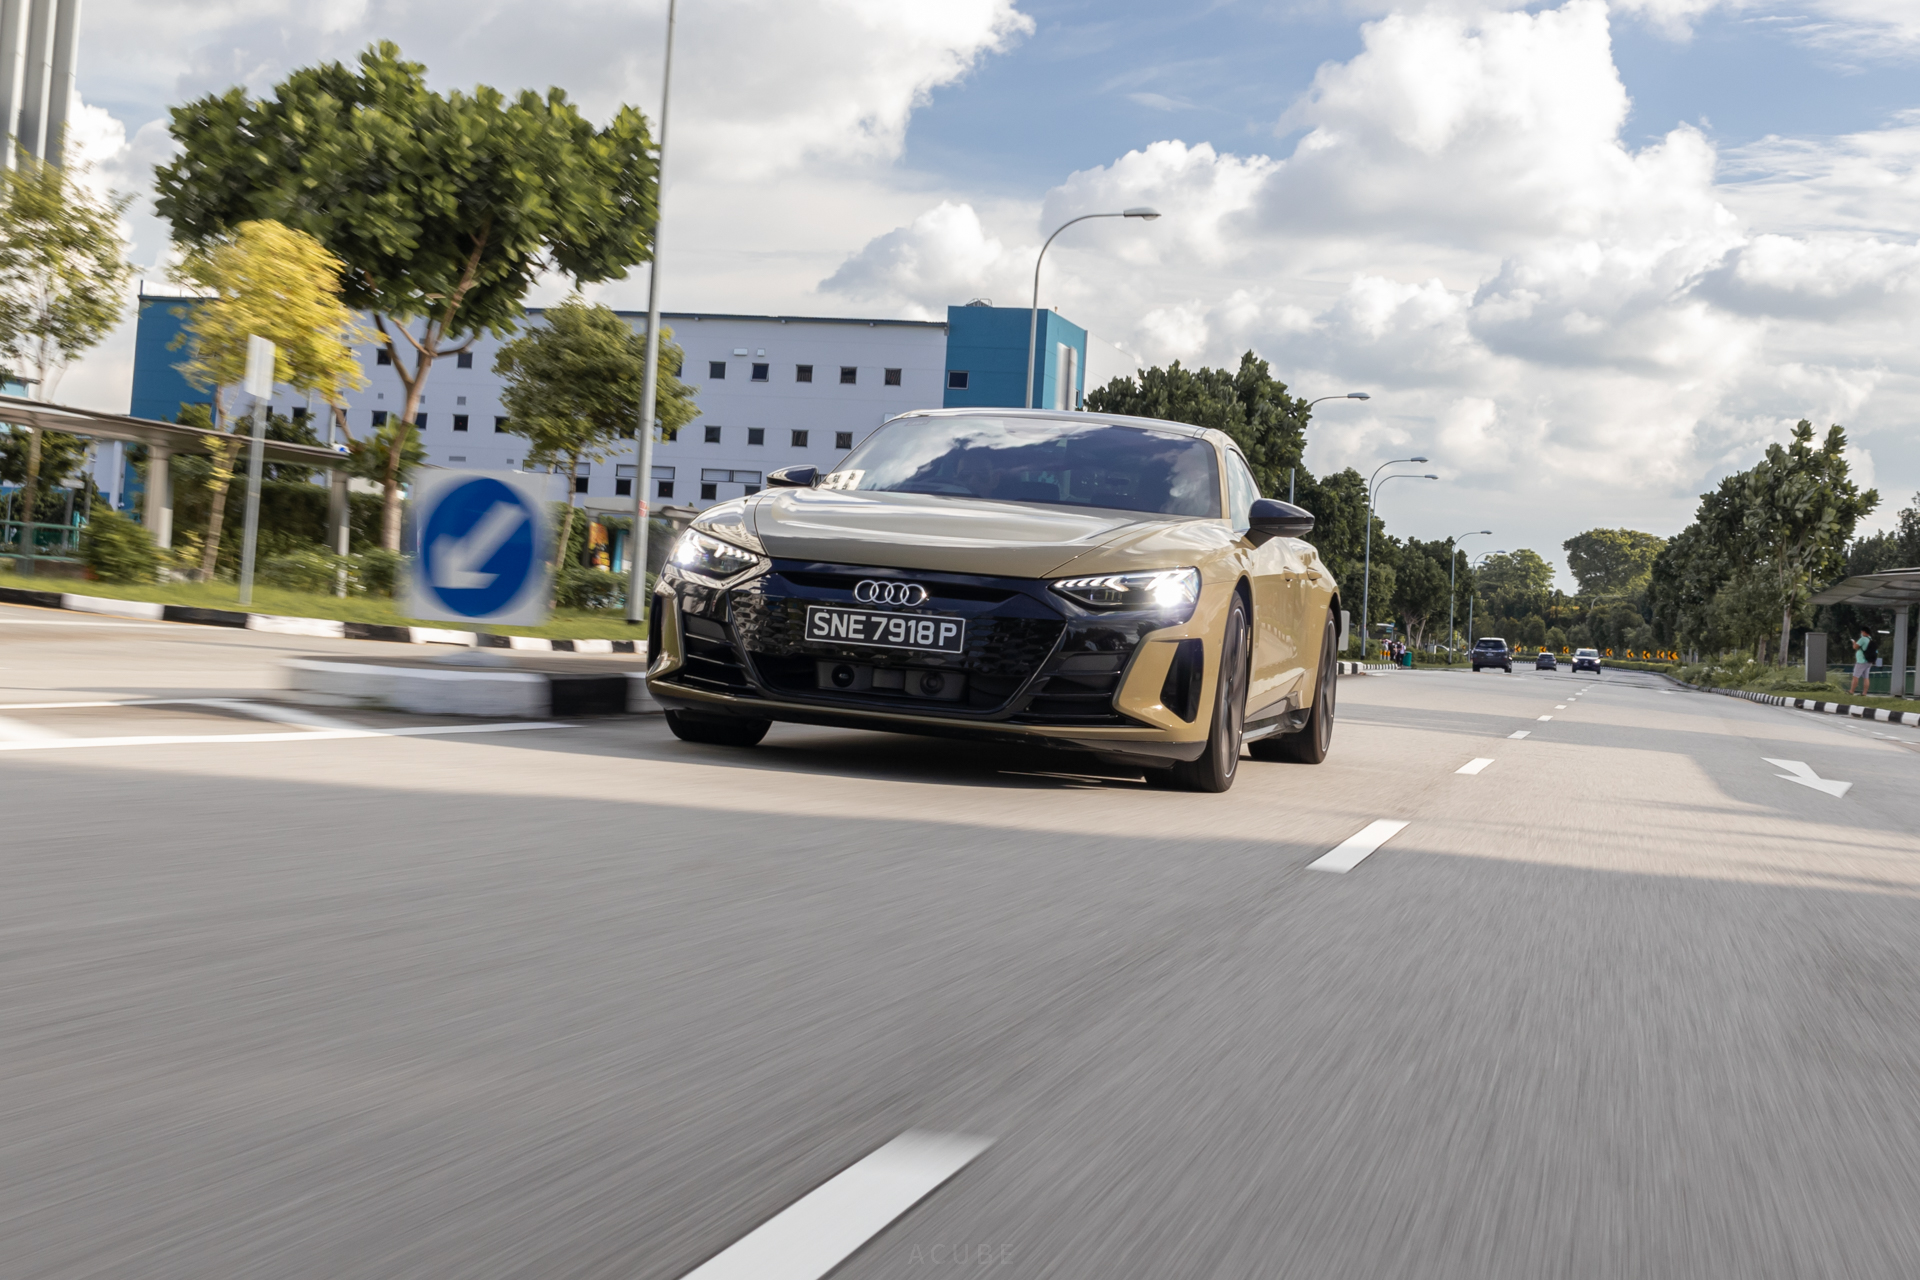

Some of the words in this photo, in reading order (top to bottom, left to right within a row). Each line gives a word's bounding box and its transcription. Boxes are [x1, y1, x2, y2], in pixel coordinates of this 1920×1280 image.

[812, 611, 867, 639] SNE
[870, 616, 935, 645] 7918
[938, 622, 957, 646] P
